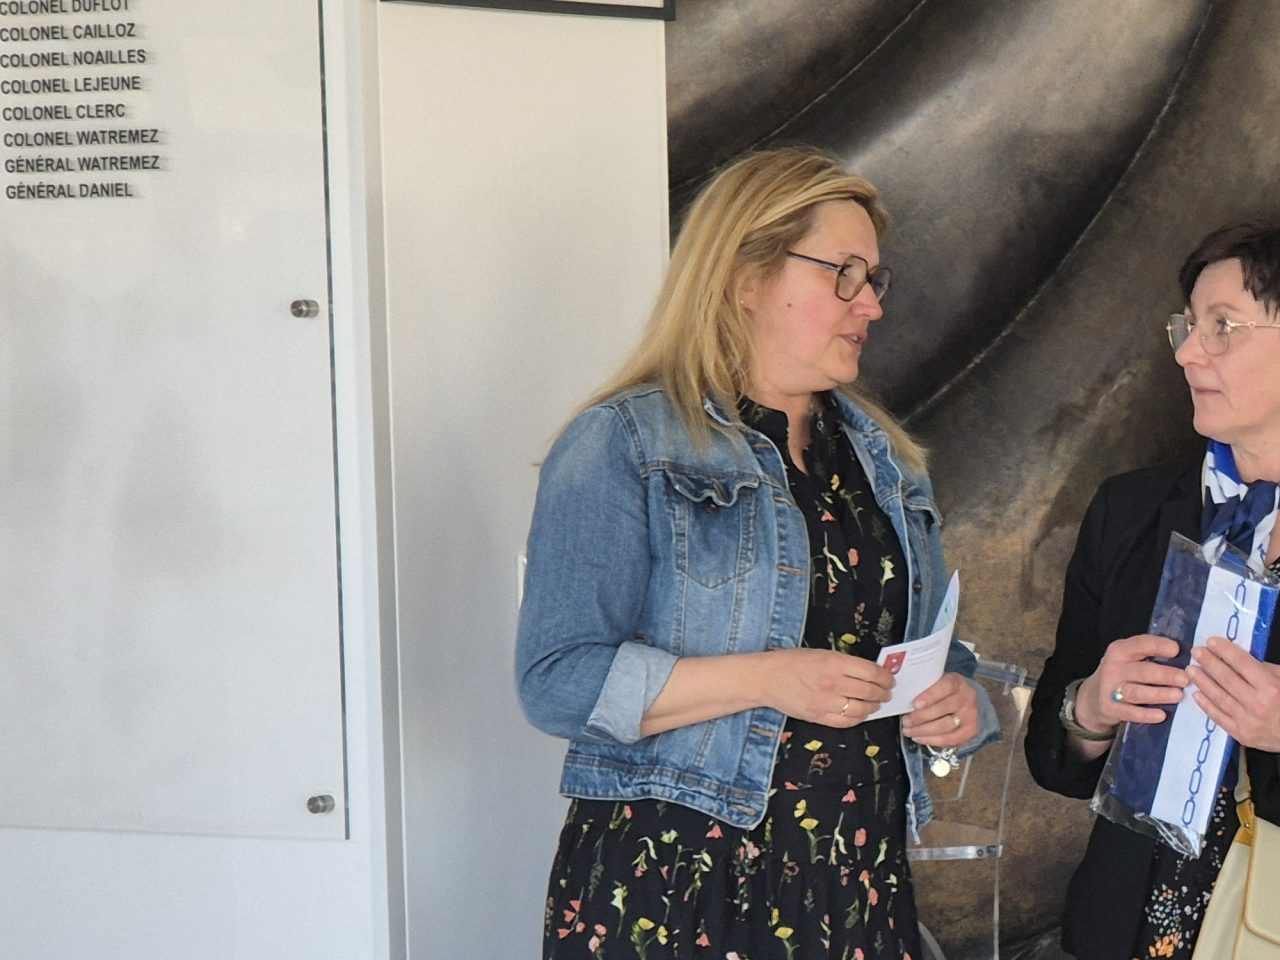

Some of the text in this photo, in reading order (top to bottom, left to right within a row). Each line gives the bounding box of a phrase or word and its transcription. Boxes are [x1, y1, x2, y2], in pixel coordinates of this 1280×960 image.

[0, 0, 68, 15] COLONEL
[0, 23, 136, 42] COLONEL CAILLOZ
[0, 49, 146, 68] COLONEL NOAILLES
[1, 76, 141, 94] COLONEL LEJEUNE
[2, 104, 126, 121] COLONEL CLERC
[3, 129, 159, 147] COLONEL WATREMEZ
[4, 155, 160, 173] GÉNÉRAL WATREMEZ
[5, 181, 133, 199] GÉNÉRAL DANIEL
